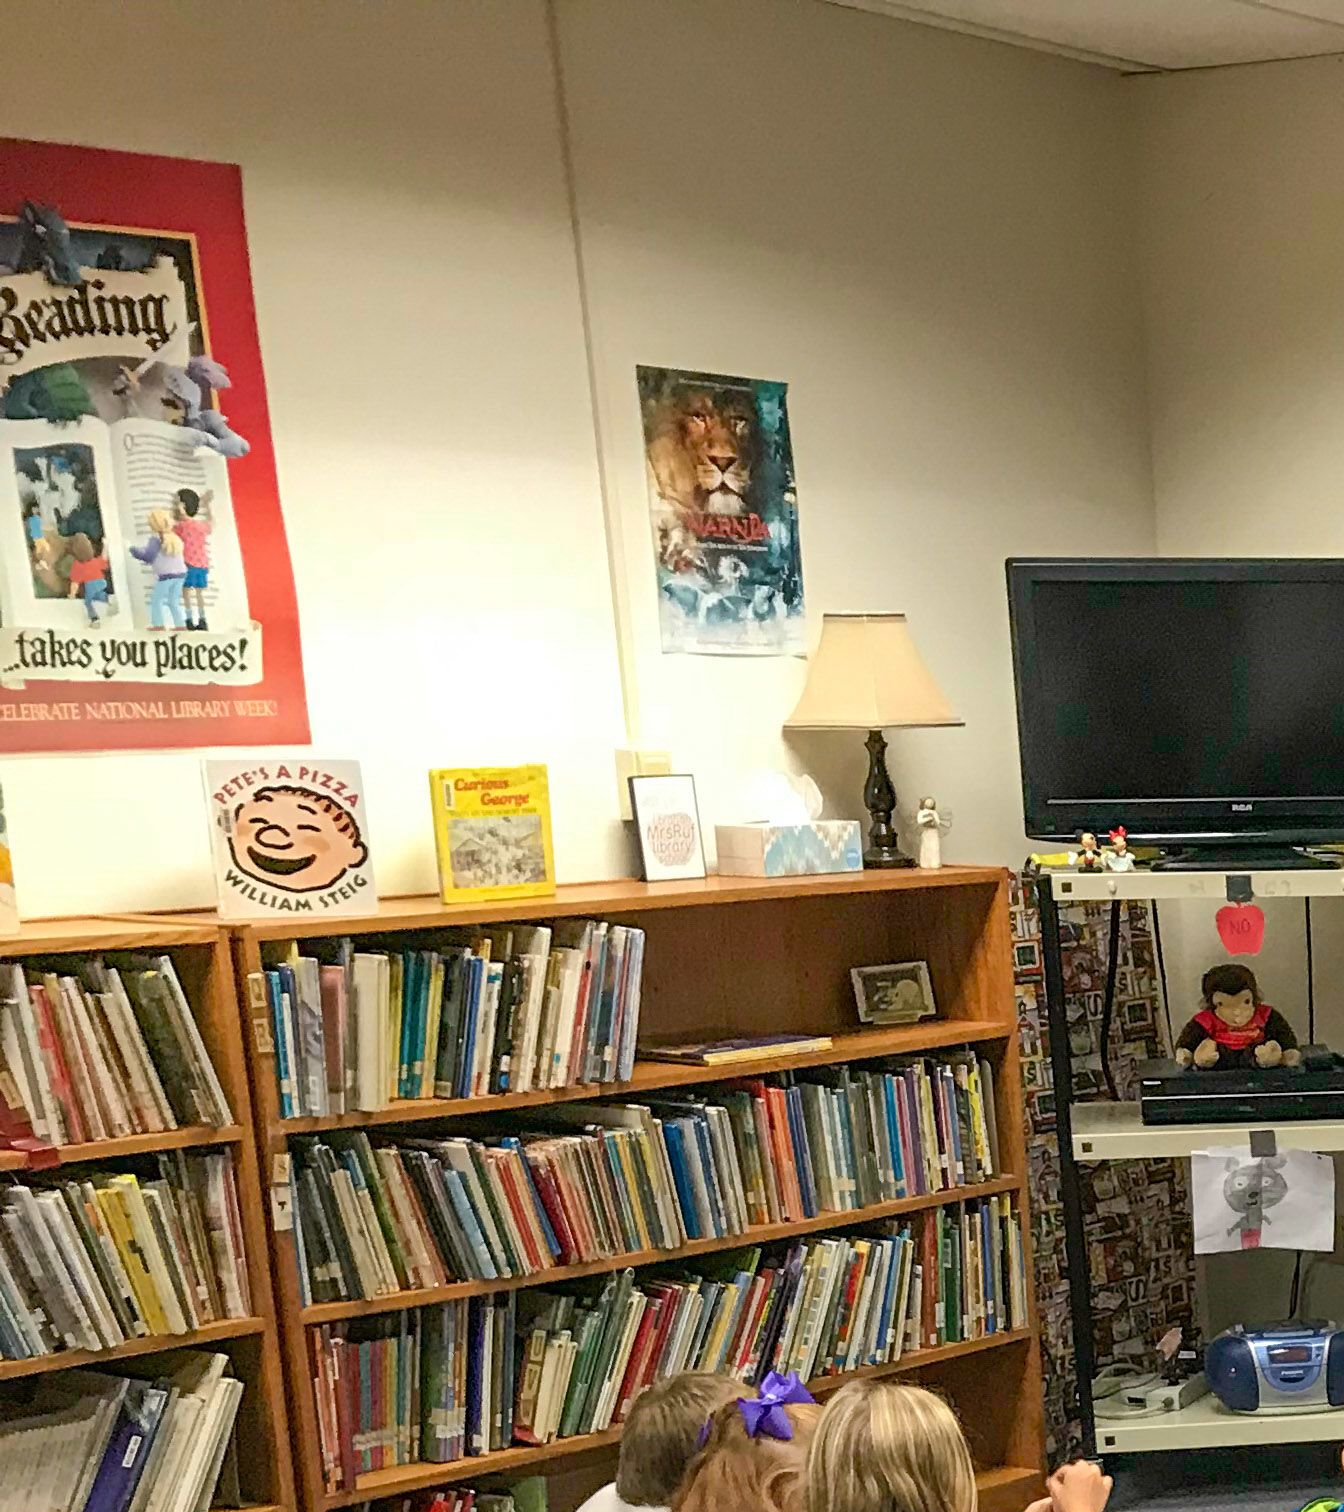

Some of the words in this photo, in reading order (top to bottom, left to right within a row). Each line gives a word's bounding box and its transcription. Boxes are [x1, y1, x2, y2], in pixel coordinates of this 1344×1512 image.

[95, 638, 150, 680] you
[153, 633, 249, 679] places!
[86, 702, 169, 720] NATIONAL
[171, 701, 232, 719] LIBRARY
[213, 766, 270, 805] PETE'S
[276, 765, 292, 779] A
[299, 766, 360, 808] PIZZA
[454, 778, 510, 792] Curious
[480, 792, 530, 807] George
[224, 868, 314, 912] WILLIAM
[318, 873, 369, 909] STEIG
